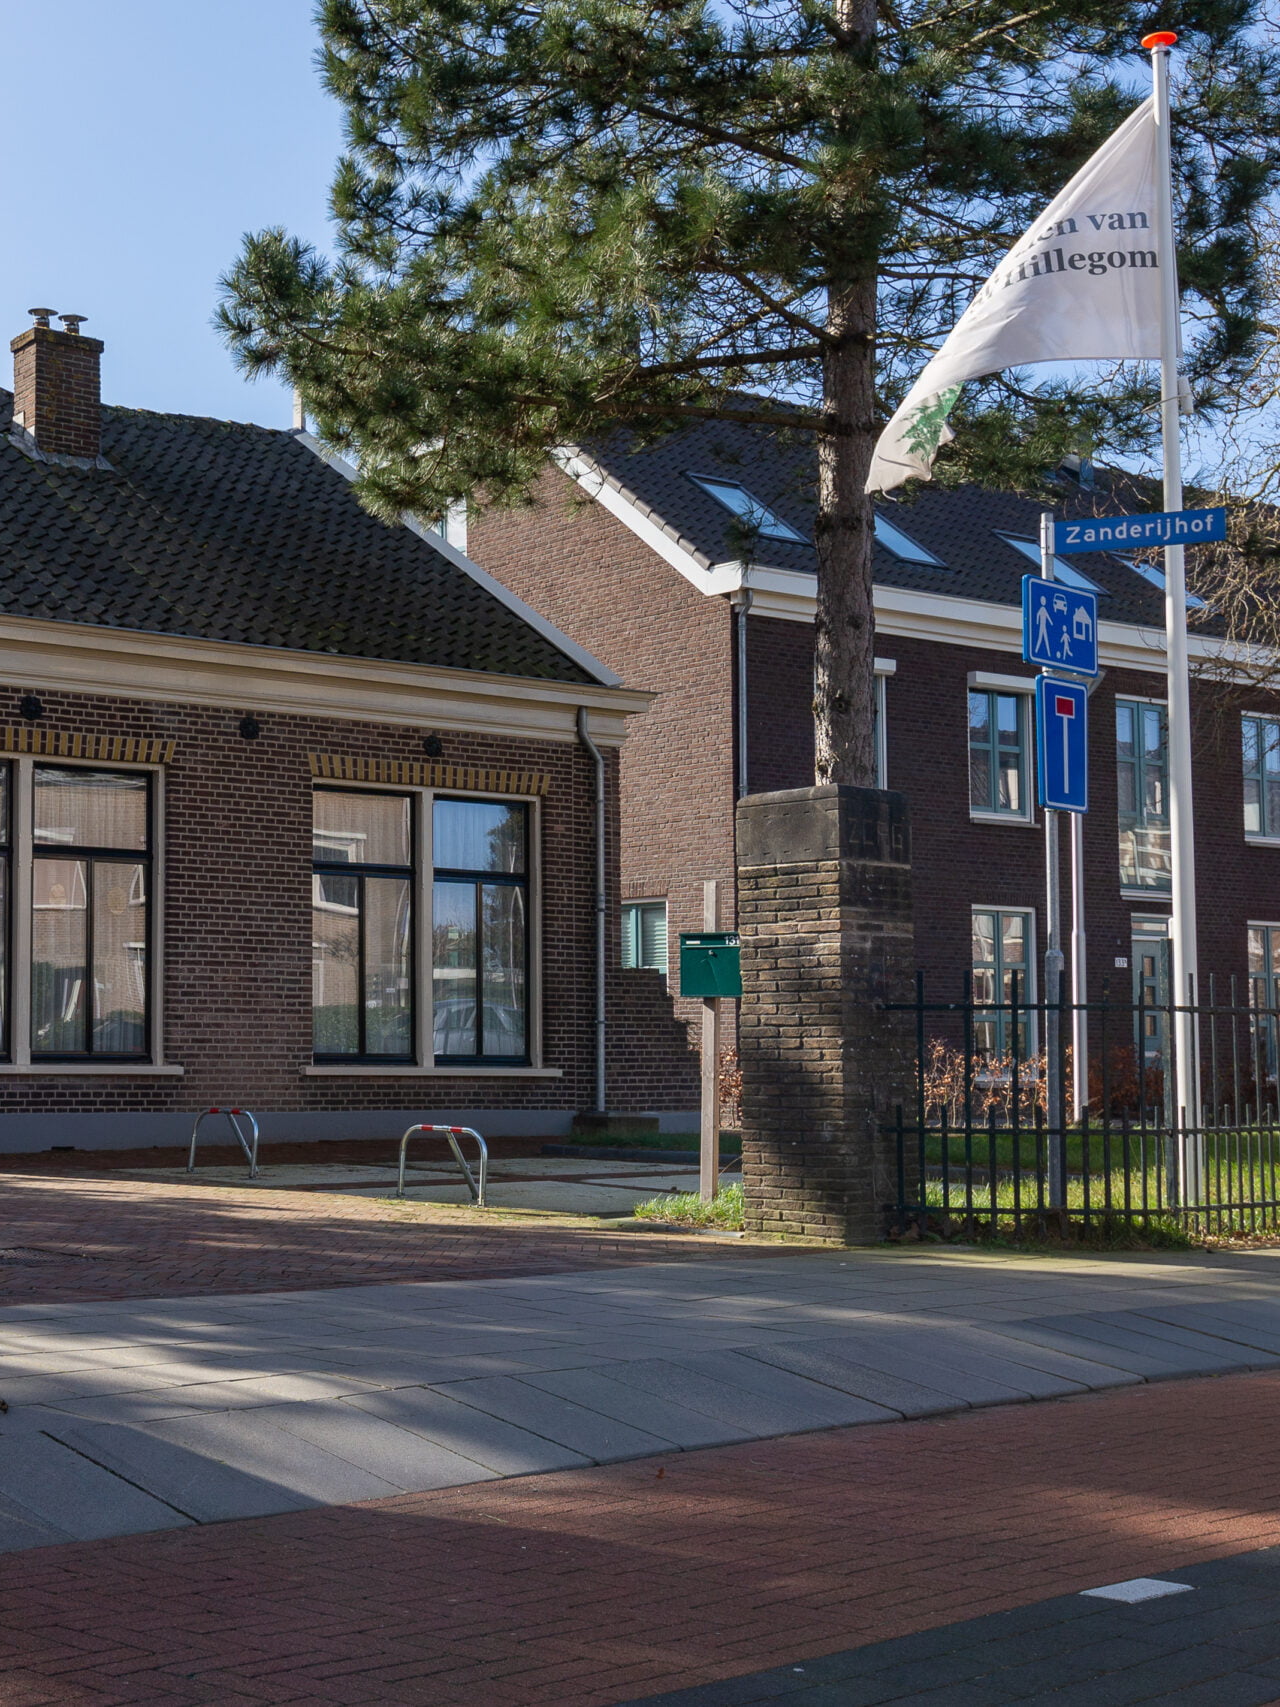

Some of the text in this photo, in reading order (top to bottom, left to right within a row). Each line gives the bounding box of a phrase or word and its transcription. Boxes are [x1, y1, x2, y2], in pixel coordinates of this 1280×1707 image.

[1087, 210, 1150, 231] van
[1066, 514, 1214, 544] Zanderijhof
[724, 935, 740, 945] 131
